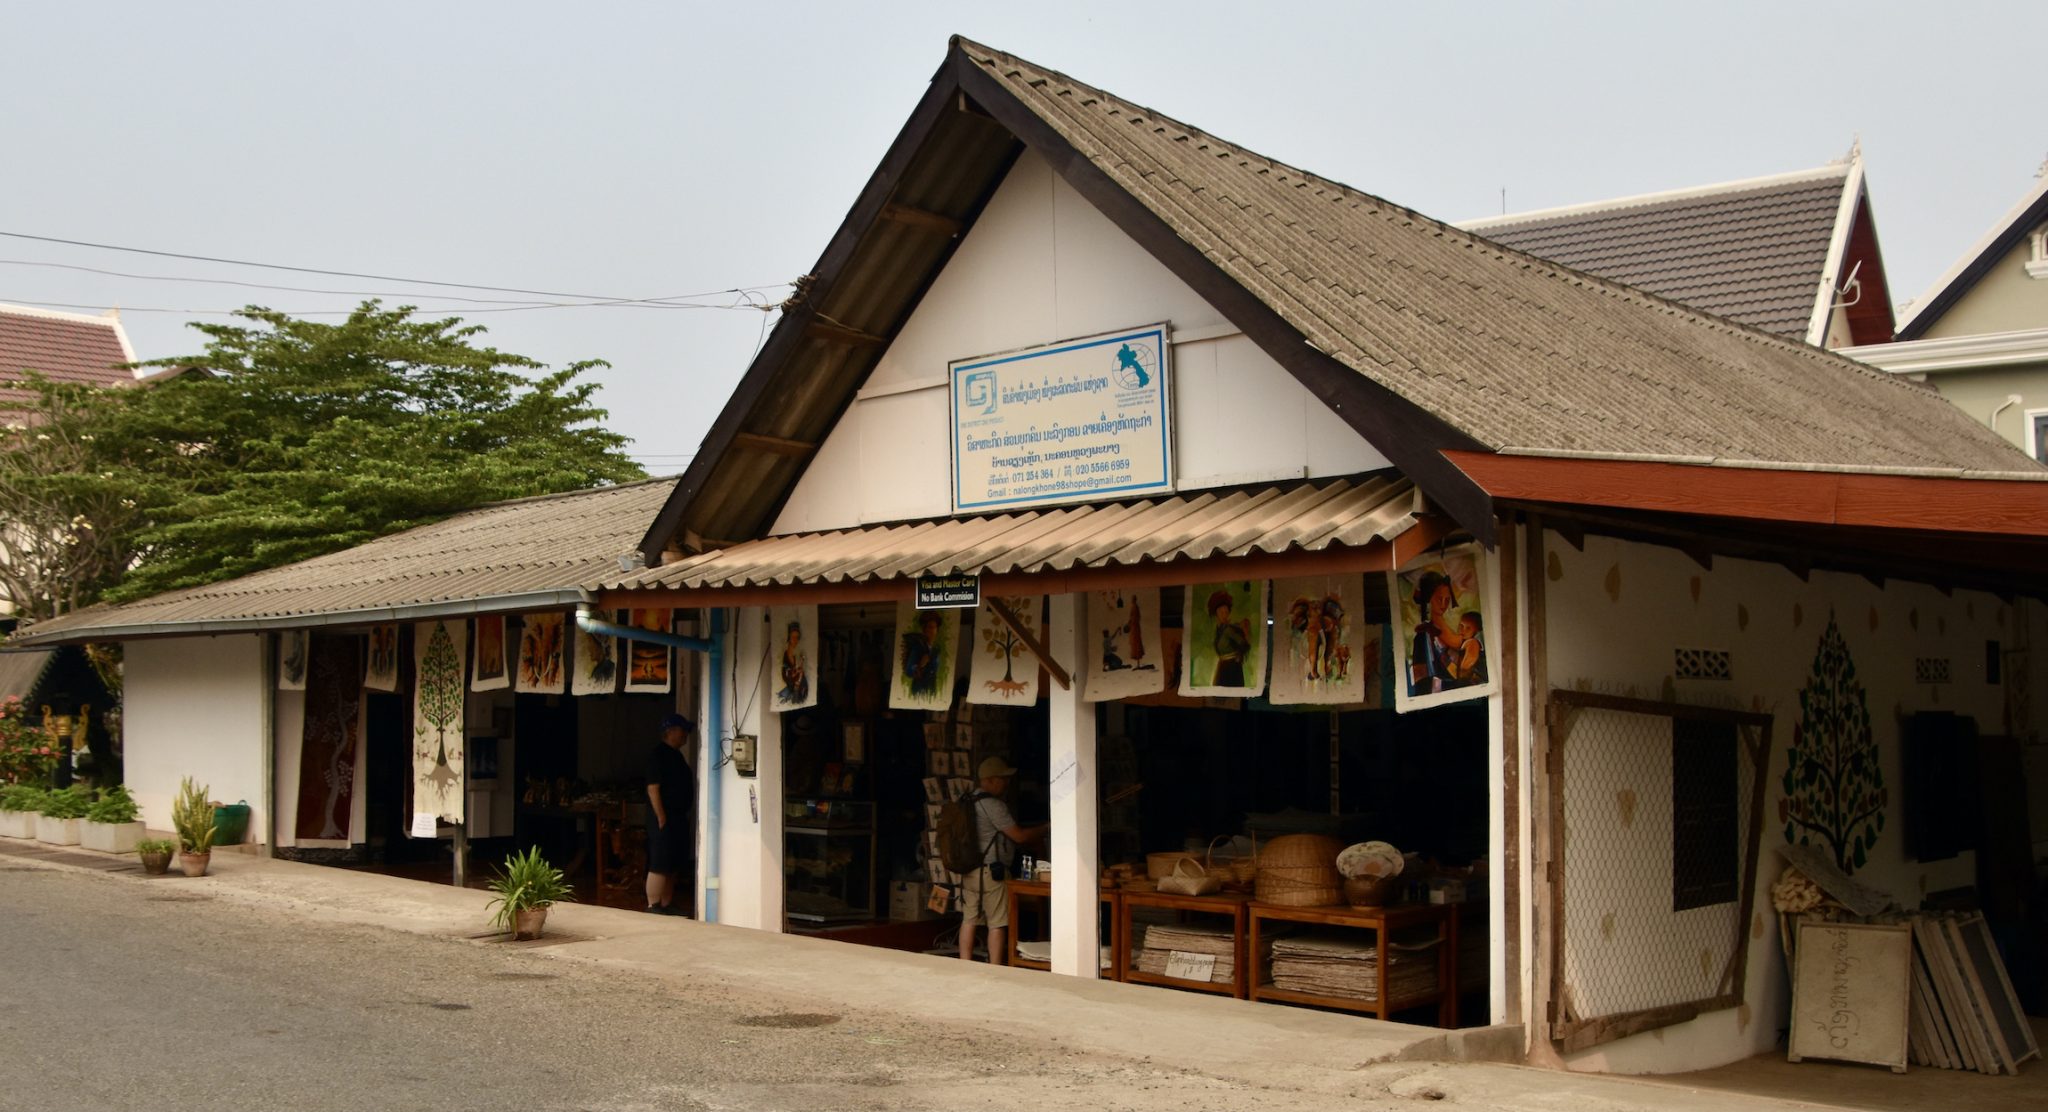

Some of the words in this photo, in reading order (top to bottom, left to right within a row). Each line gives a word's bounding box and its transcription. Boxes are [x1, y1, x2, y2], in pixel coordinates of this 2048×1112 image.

[1012, 472, 1024, 483] 071
[1075, 464, 1089, 475] 020
[1091, 462, 1109, 473] 5566
[1111, 459, 1130, 470] 6959
[987, 488, 1006, 498] Gmail
[921, 592, 930, 602] No
[930, 592, 943, 602] Bank
